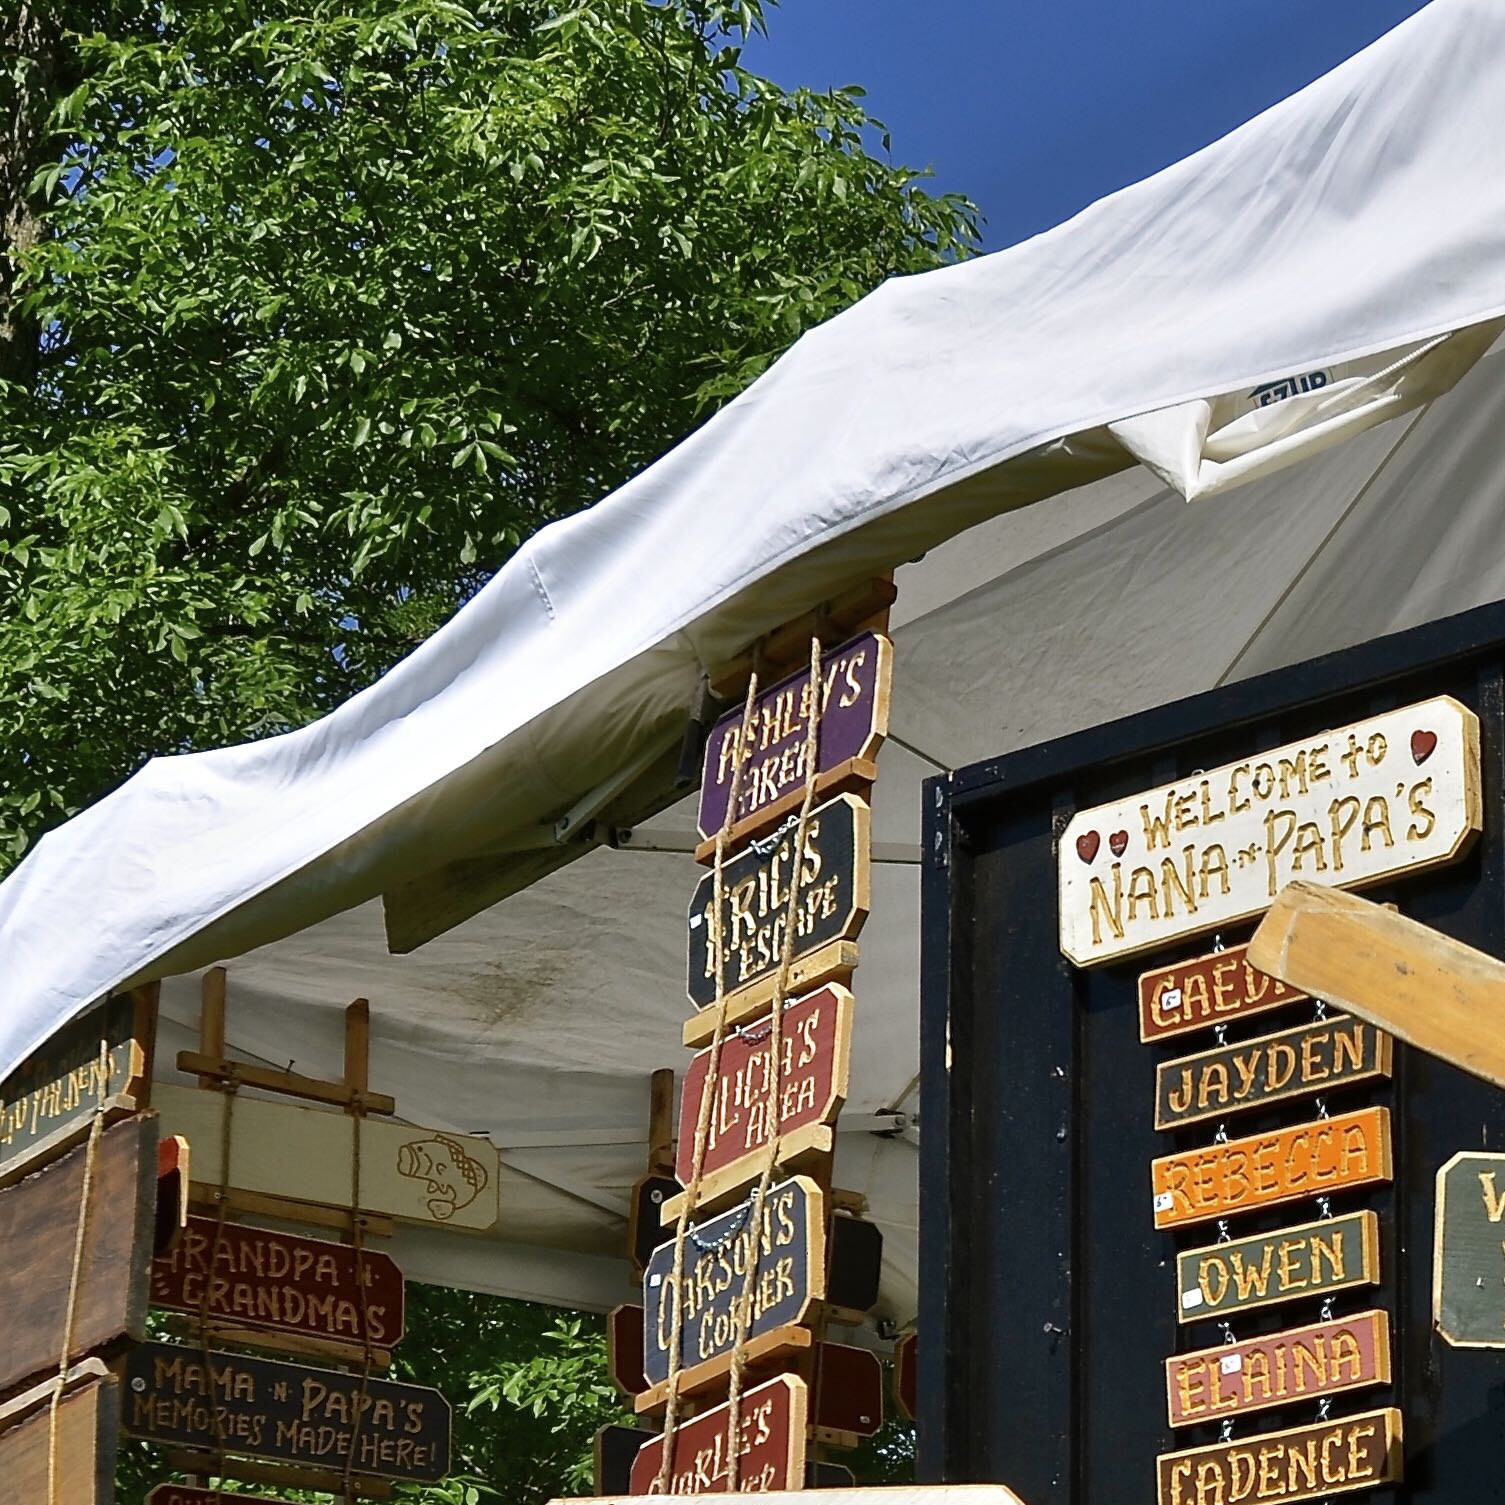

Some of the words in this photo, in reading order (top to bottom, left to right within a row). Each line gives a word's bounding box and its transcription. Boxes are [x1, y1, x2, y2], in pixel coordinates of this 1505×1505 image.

[1140, 746, 1331, 850] WELCOME
[1088, 844, 1231, 945] NANA
[1264, 776, 1437, 897] PAPA'S
[1168, 1023, 1366, 1114] JAYDEN
[1163, 1123, 1369, 1217] REBECCA
[1197, 1229, 1346, 1308] OWEN
[155, 1357, 254, 1401] MAMA
[301, 1377, 423, 1434] PAPA'S
[1175, 1329, 1363, 1418] ELAINA
[133, 1394, 266, 1446] MEMORIES
[277, 1419, 349, 1459] MADE
[360, 1432, 436, 1471] HERE!
